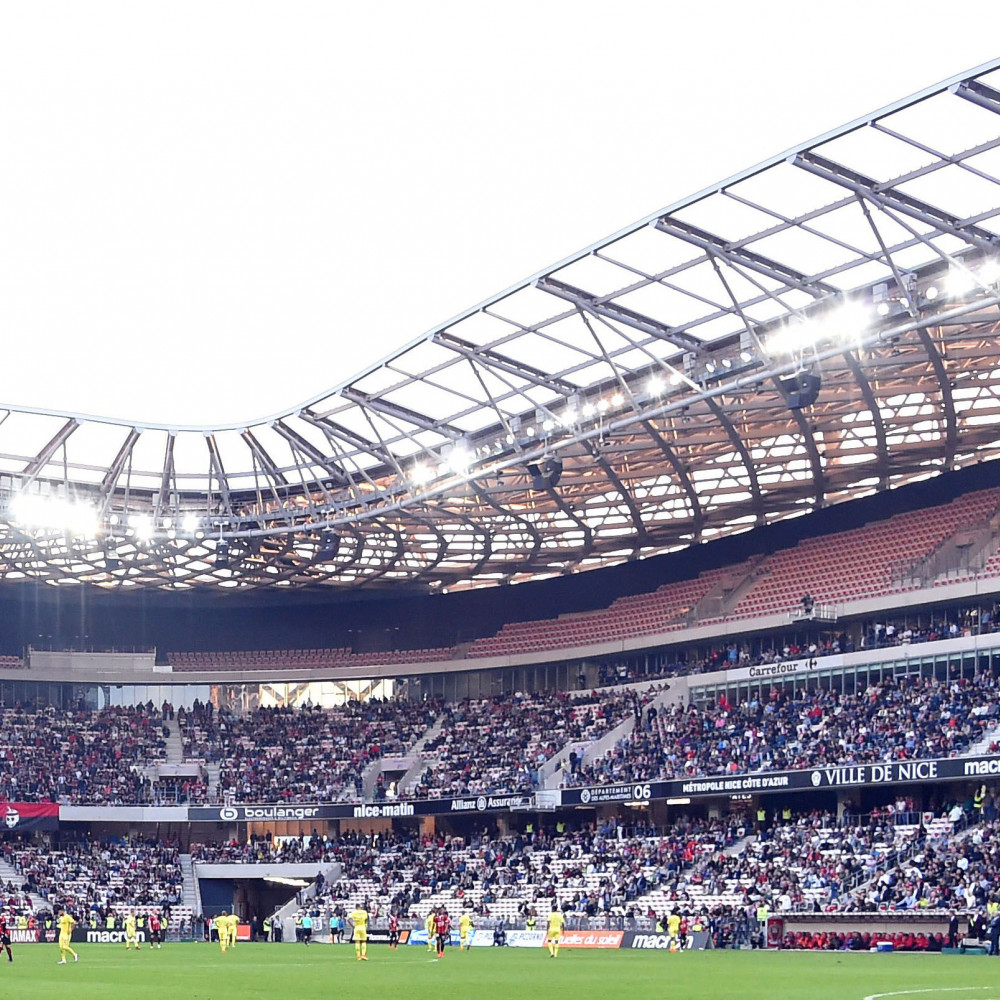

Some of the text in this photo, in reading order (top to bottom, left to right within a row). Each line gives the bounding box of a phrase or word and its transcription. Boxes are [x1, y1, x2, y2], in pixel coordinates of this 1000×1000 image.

[749, 663, 798, 677] Carrefour
[826, 762, 938, 785] VILLE DE NICE
[683, 781, 724, 792] MÉTROPOLE
[725, 780, 741, 790] NICE
[743, 777, 760, 788] CÔTE
[634, 785, 651, 799] 06
[451, 800, 476, 810] Allianz
[245, 807, 319, 820] boulanger
